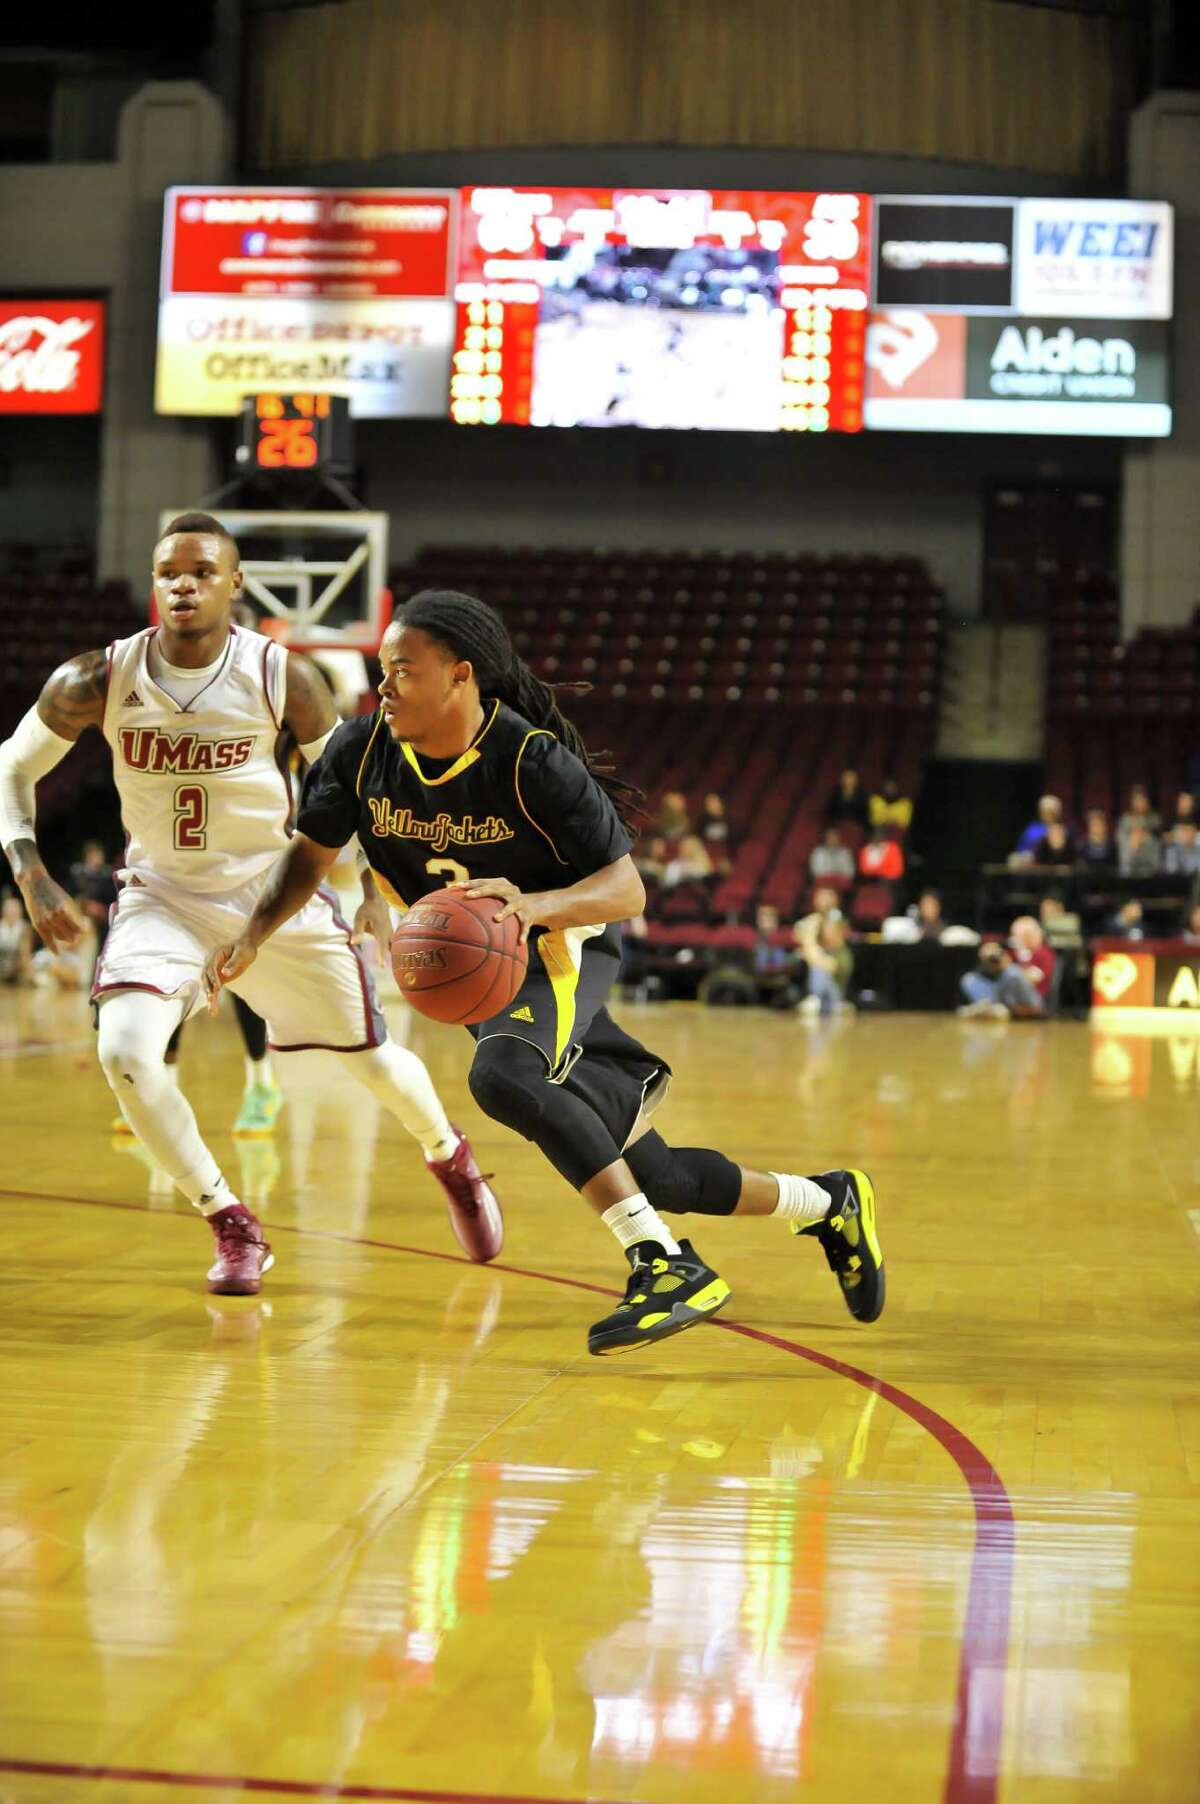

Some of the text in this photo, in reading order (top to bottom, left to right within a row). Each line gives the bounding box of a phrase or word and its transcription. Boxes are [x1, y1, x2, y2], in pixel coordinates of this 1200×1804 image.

[1033, 220, 1160, 258] WEEI
[990, 325, 1136, 374] Alden
[174, 784, 208, 850] 2
